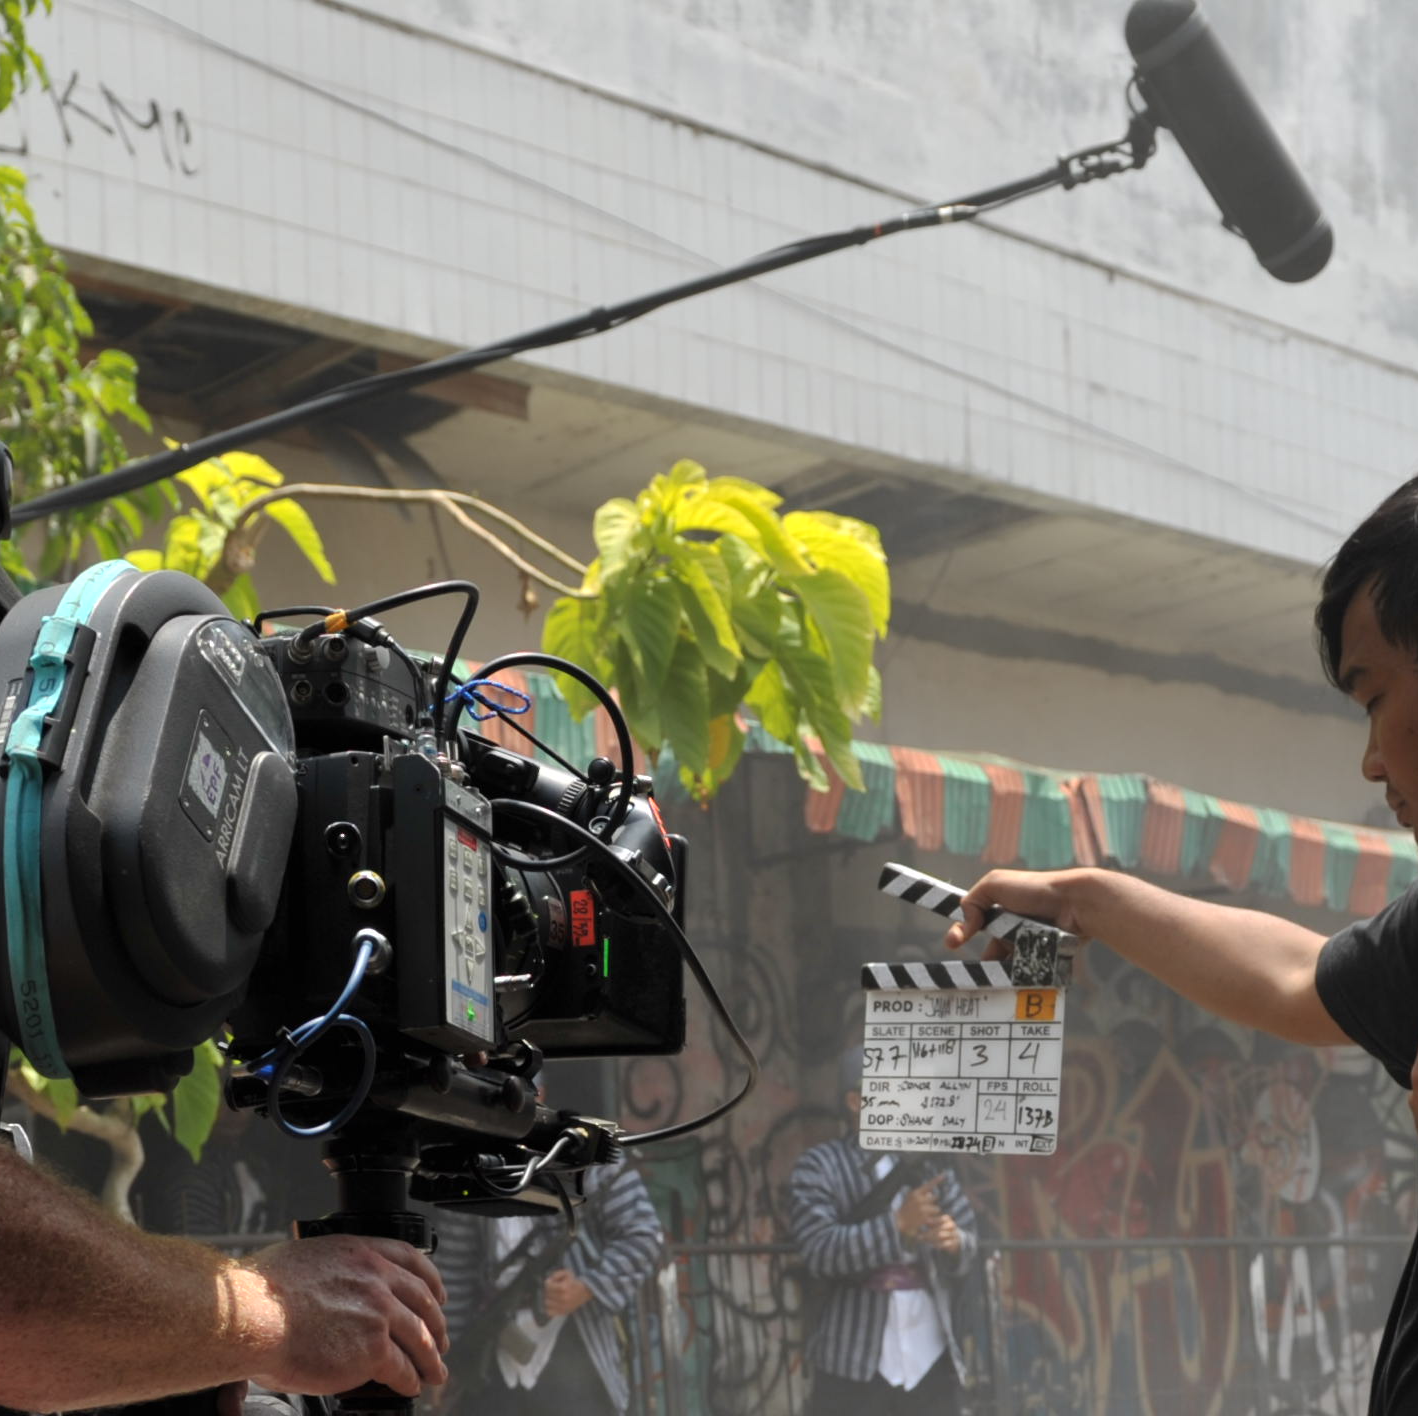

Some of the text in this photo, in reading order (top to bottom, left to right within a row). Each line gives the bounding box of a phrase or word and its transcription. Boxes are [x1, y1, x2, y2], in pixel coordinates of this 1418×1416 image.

[207, 762, 223, 806] EPF
[215, 745, 250, 869] ARRICAM LT
[20, 979, 45, 1039] 5201
[1026, 993, 1043, 1018] B
[872, 1025, 906, 1036] SLATE
[918, 1025, 955, 1036] SCENE
[969, 1026, 1001, 1036] SHOT
[1021, 1025, 1051, 1036] TAKE
[970, 1044, 989, 1067] 3
[1018, 1042, 1040, 1075] 4
[869, 1081, 890, 1092] DIR
[986, 1082, 1009, 1091] FPS
[1023, 1082, 1053, 1092] ROLL
[983, 1098, 1007, 1121] 24
[866, 1137, 892, 1146] DATE
[1015, 1140, 1029, 1148] INT
